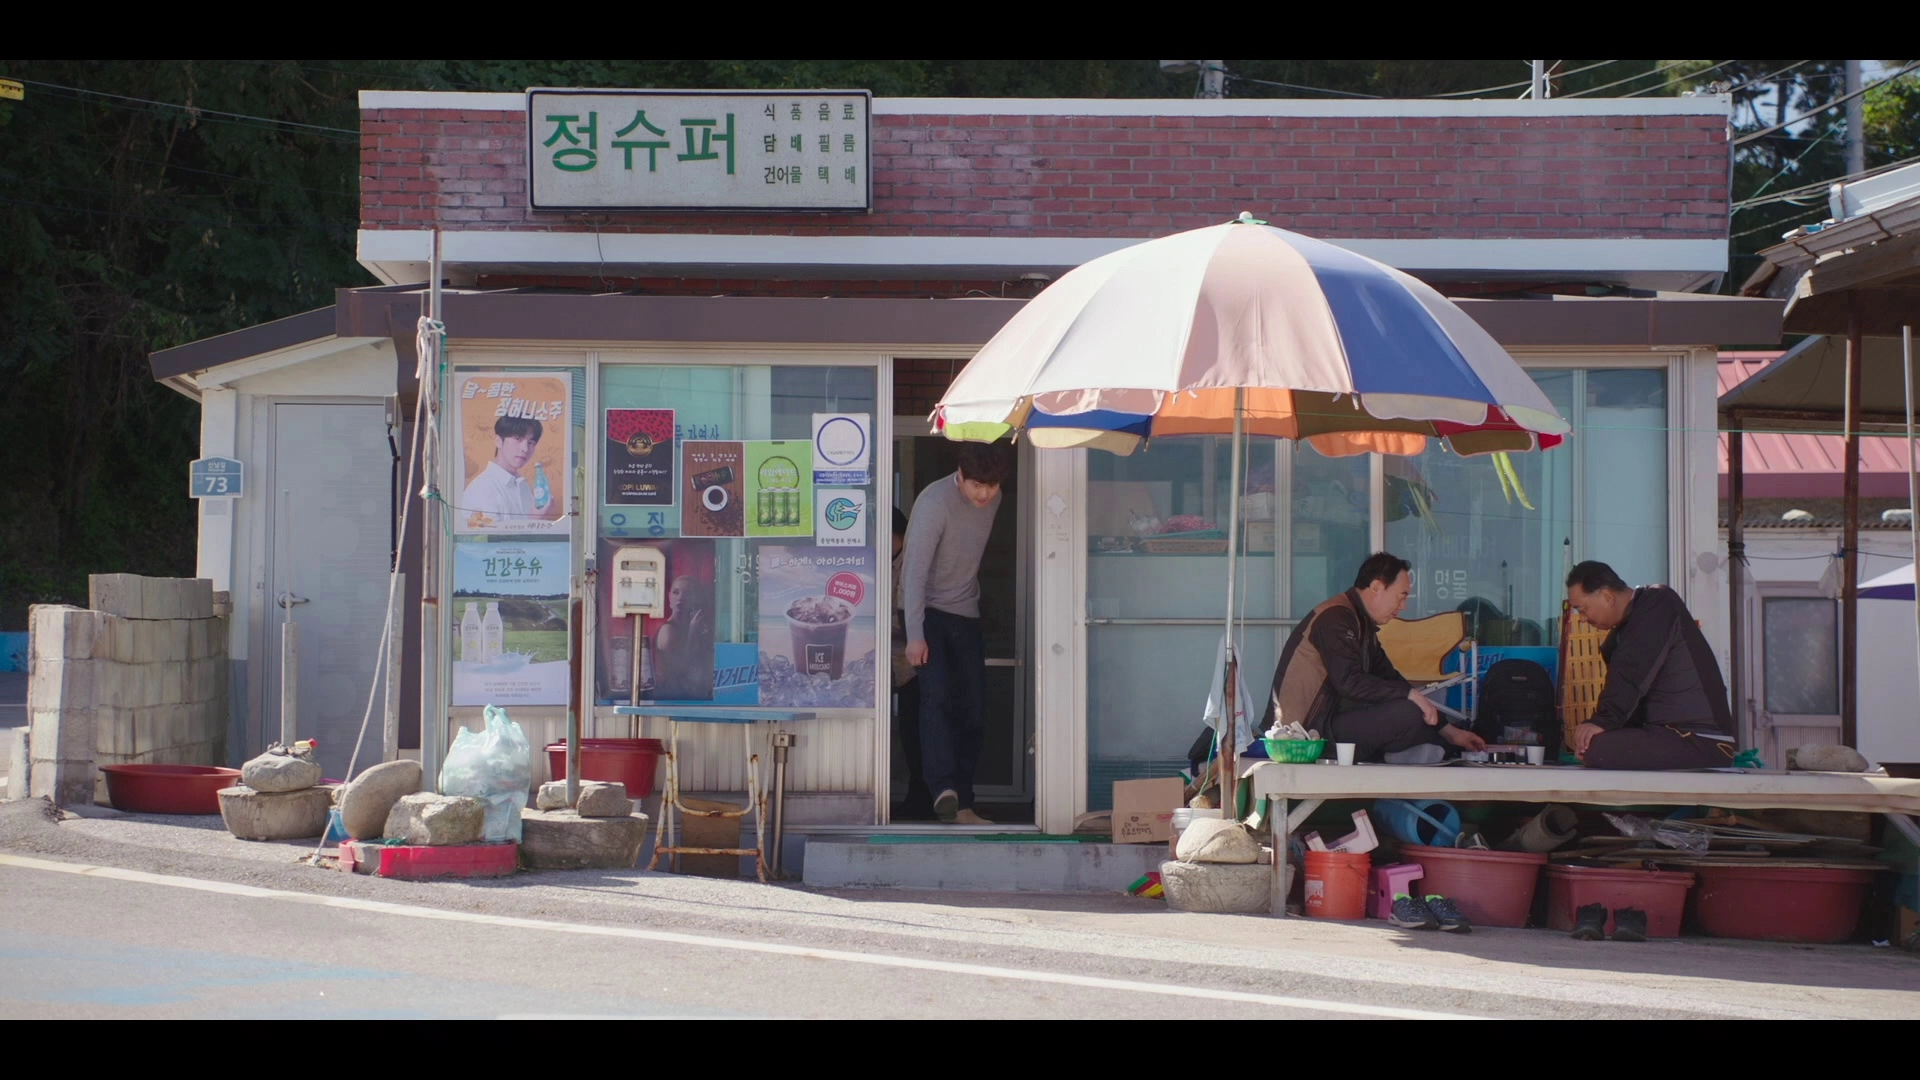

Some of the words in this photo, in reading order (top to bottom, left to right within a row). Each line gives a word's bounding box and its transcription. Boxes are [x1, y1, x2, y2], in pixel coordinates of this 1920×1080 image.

[542, 109, 736, 176] 정슈퍼
[763, 165, 802, 185] 건어물
[818, 165, 856, 185] 택배
[205, 477, 228, 493] 73
[482, 557, 543, 577] 건강우유
[816, 556, 865, 567] 아이스커피
[814, 652, 825, 663] ICE
